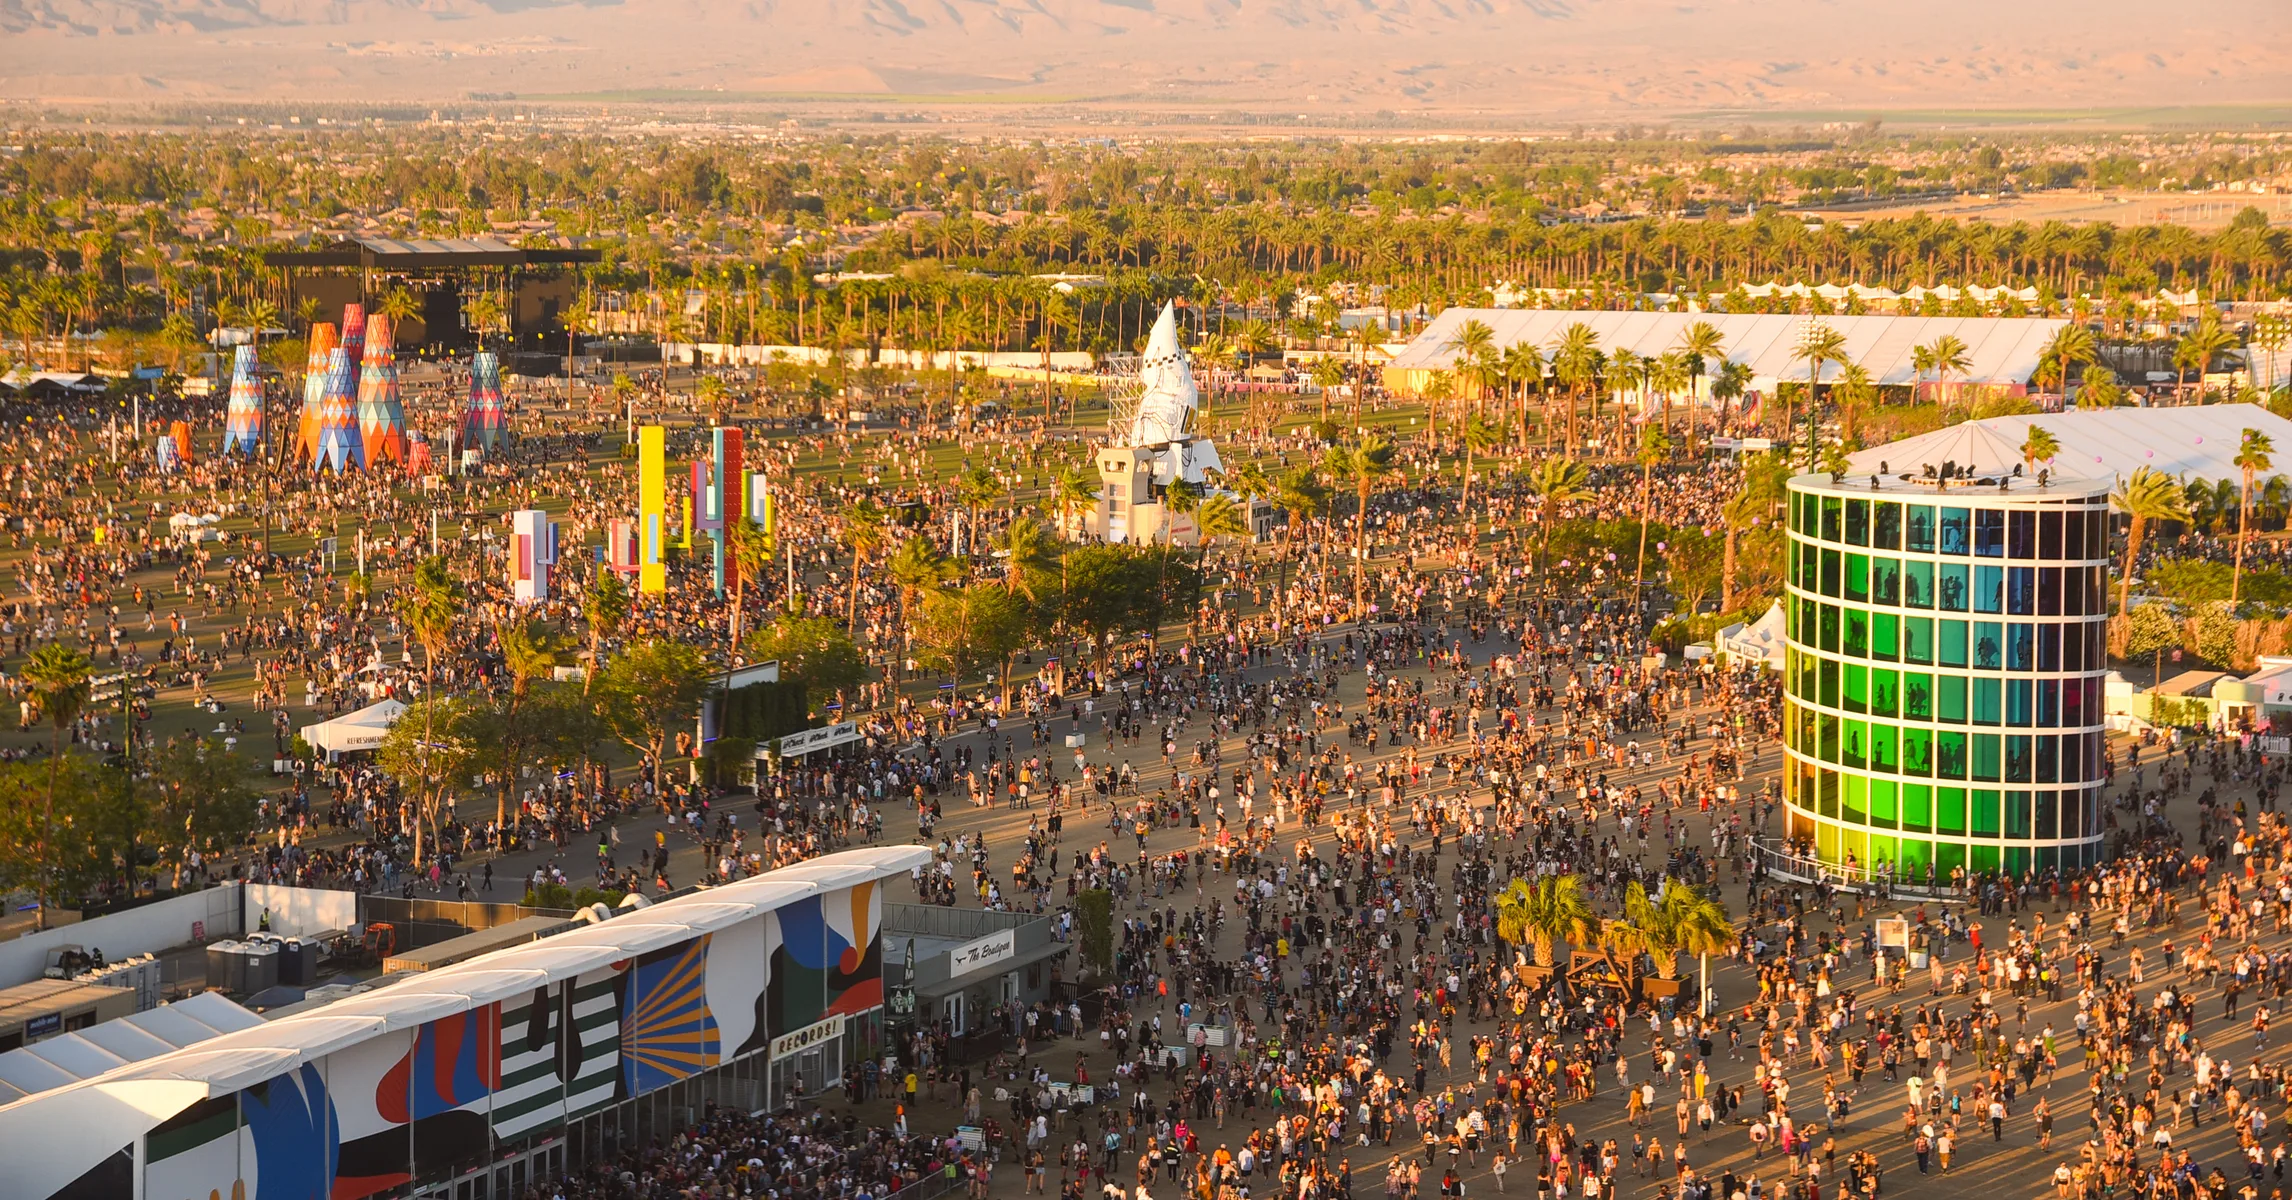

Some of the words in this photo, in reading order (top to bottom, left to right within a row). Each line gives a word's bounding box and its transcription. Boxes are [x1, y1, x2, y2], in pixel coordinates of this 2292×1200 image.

[905, 946, 914, 980] ATM
[968, 947, 980, 963] The
[981, 941, 1010, 958] Boutique
[779, 1020, 836, 1054] RECORDS!
